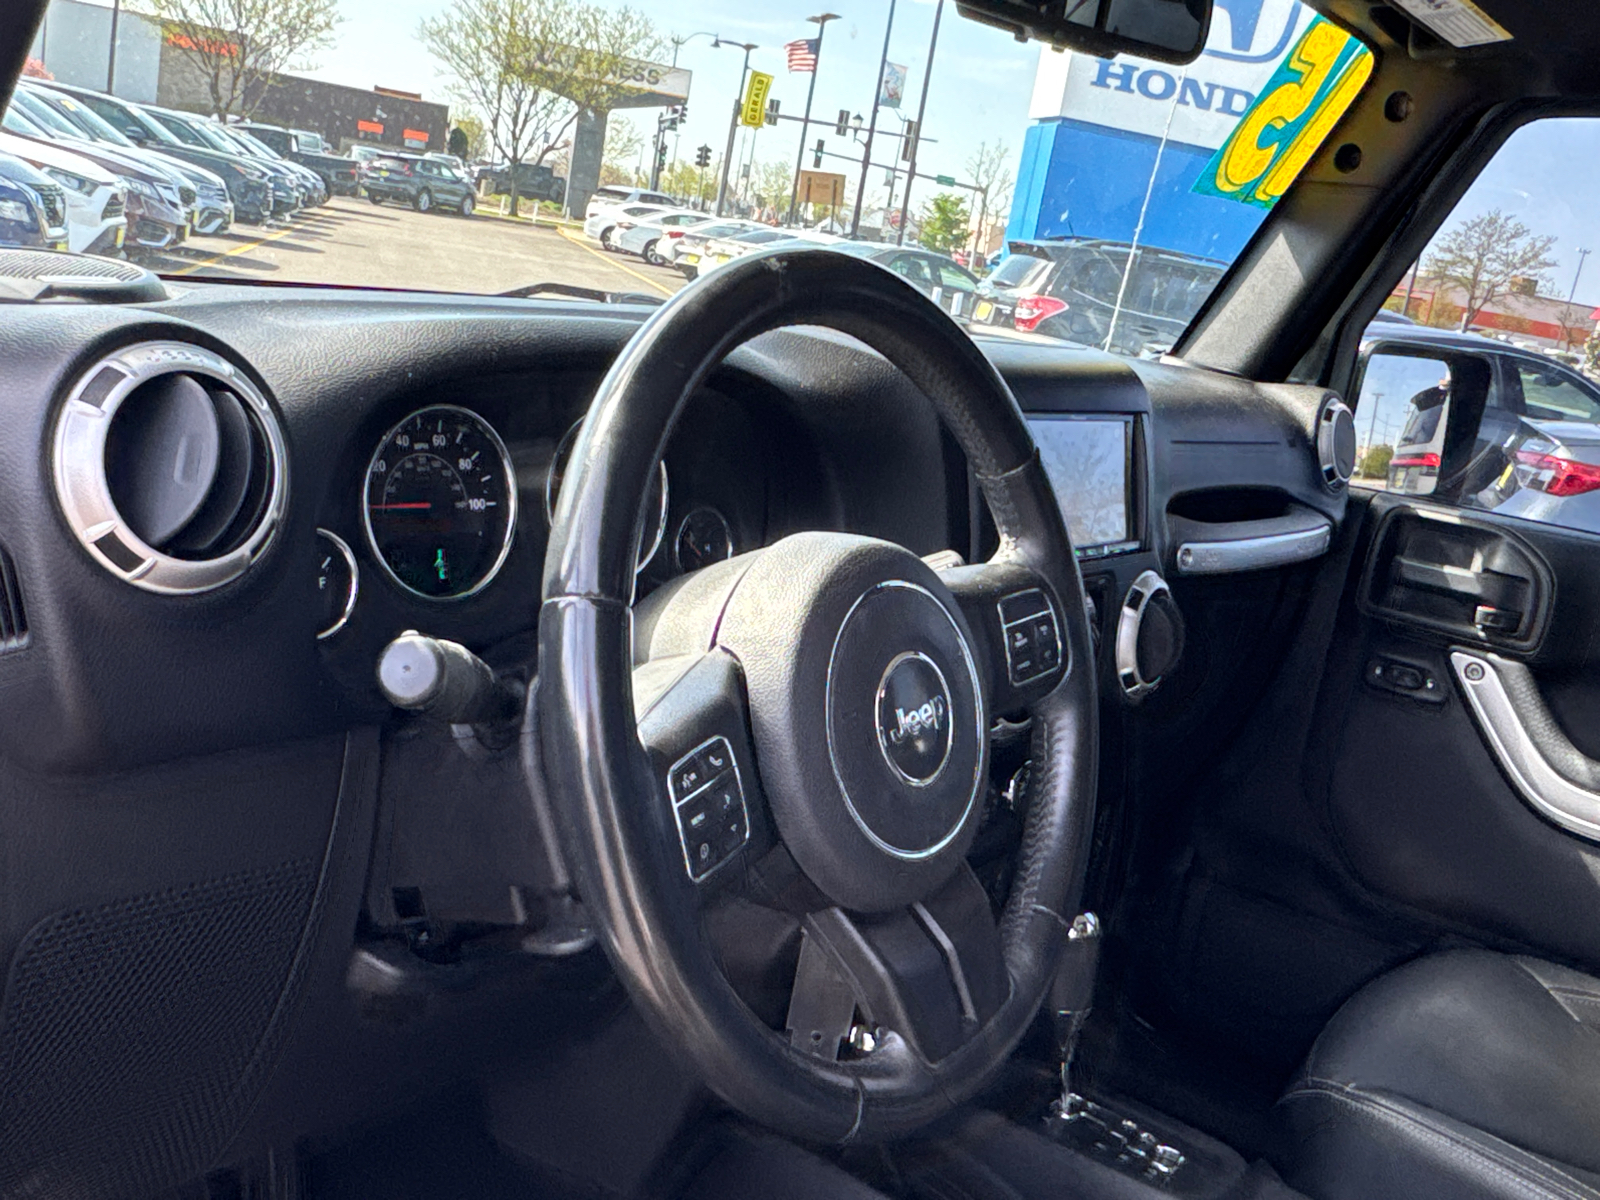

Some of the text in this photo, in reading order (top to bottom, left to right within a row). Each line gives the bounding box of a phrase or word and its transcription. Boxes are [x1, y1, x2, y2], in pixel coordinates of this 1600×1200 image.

[1090, 59, 1256, 117] HOND
[396, 435, 409, 446] 40
[432, 435, 445, 446] 60
[459, 458, 472, 470] 80
[468, 499, 486, 510] 100
[318, 576, 327, 590] F
[889, 695, 945, 744] Jeep
